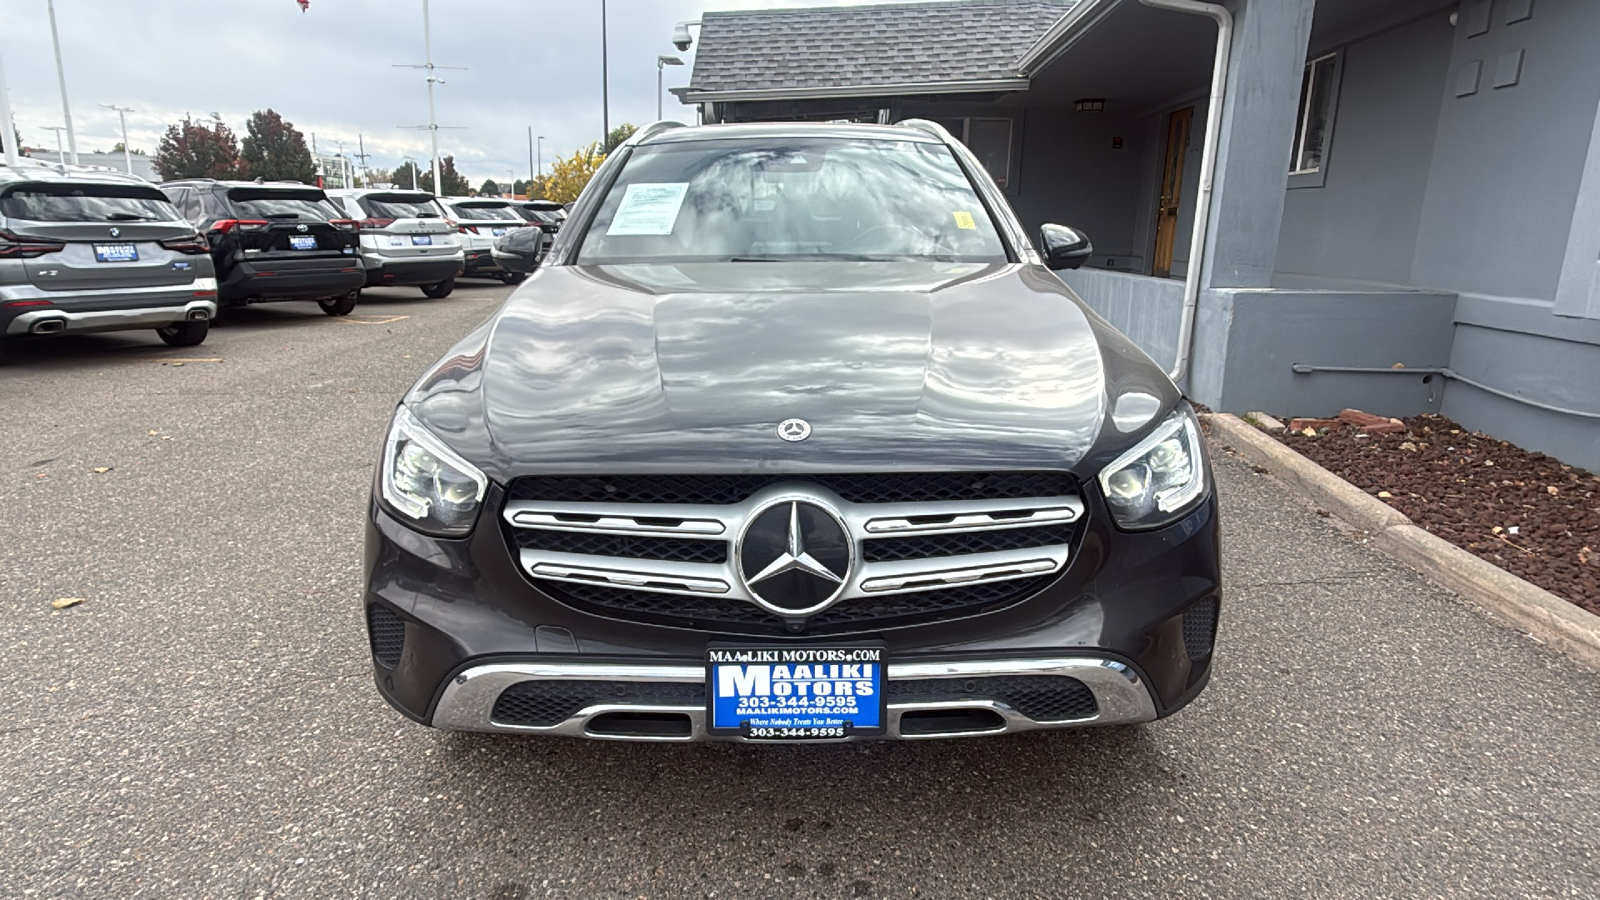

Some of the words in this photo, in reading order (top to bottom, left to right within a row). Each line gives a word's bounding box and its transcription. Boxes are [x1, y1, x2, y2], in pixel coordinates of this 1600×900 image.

[738, 696, 857, 708] 303-344-9595
[736, 707, 859, 715] MAALIKIMOTORS.COM
[770, 718, 792, 727] Nobody
[749, 728, 844, 737] 303-344-9595
